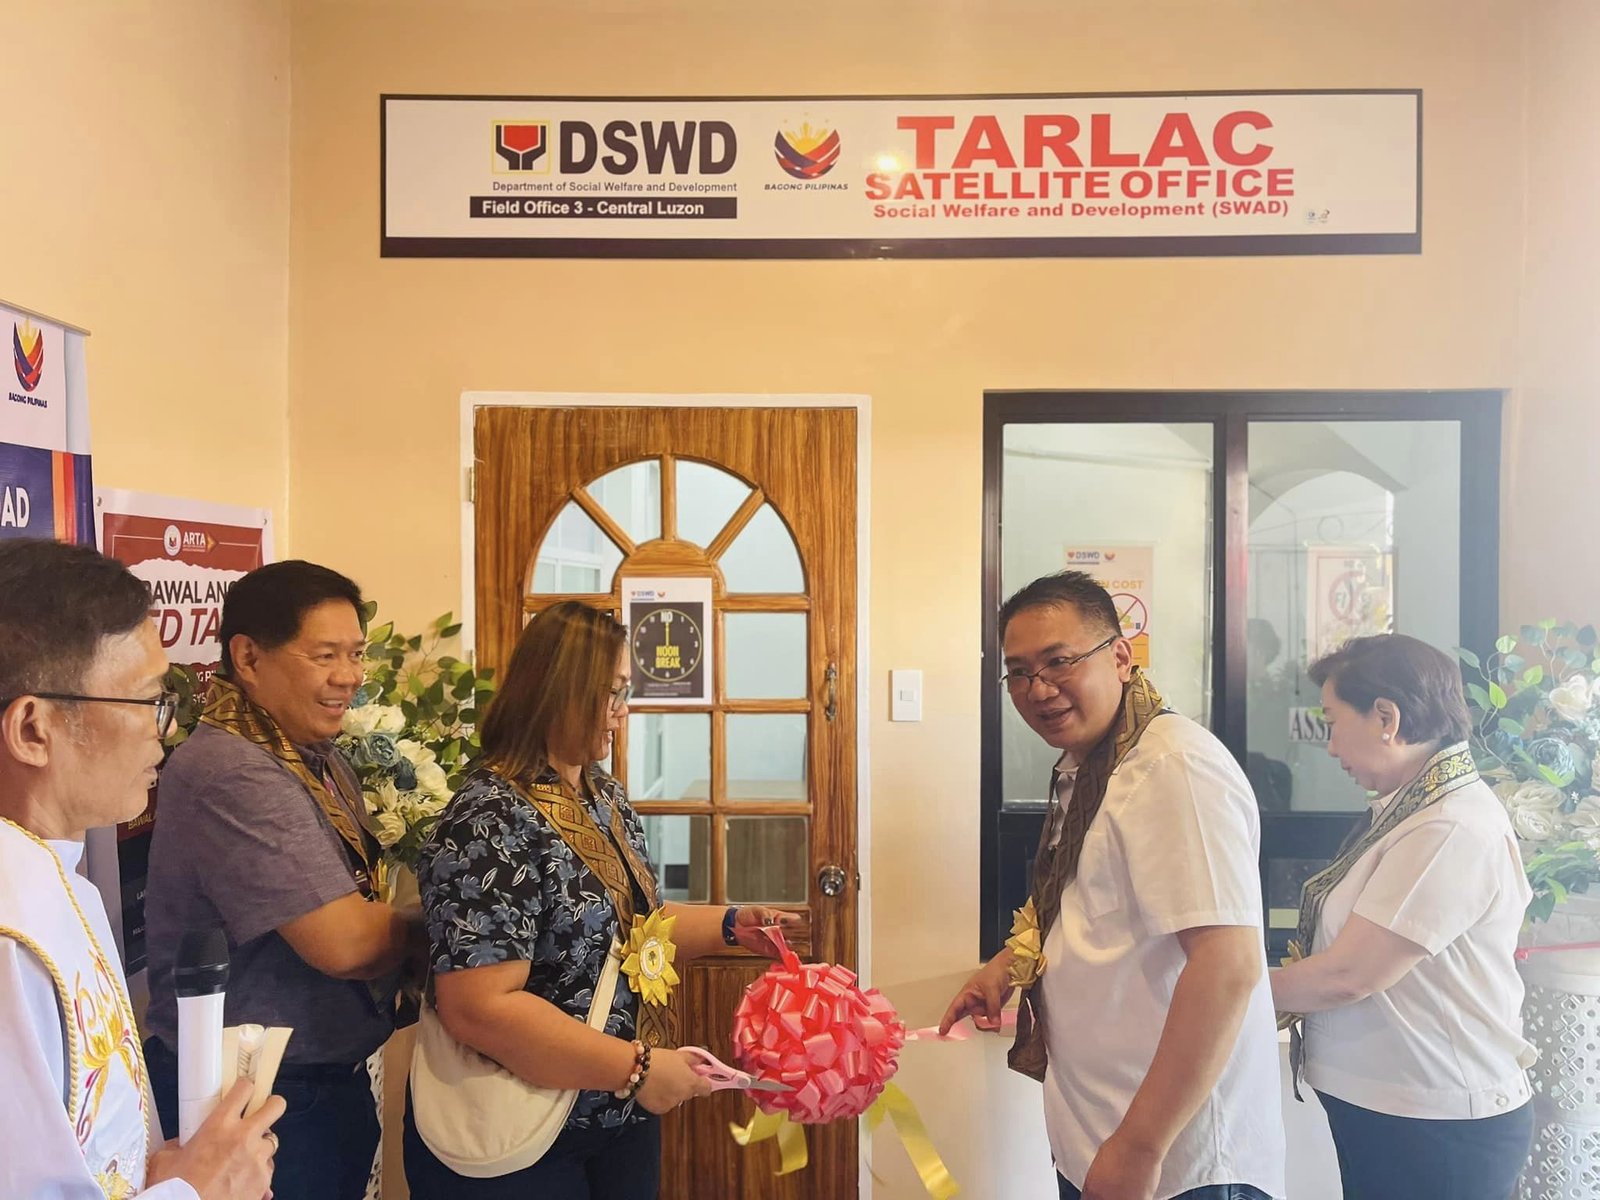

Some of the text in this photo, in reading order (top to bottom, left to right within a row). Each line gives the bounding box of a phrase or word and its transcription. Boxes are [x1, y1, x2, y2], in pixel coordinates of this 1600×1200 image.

[559, 119, 738, 175] DSWD
[896, 110, 1275, 169] TARLAC
[492, 181, 738, 194] Department of Social Welfare and Development
[764, 183, 849, 191] BAGONG PILIPINAS
[865, 168, 1295, 200] SATELLITE OFFICE
[482, 200, 520, 215] Field
[524, 200, 570, 215] Office
[574, 201, 583, 215] 3
[597, 201, 653, 215] Central
[657, 202, 705, 216] Luzon
[873, 200, 1289, 219] Social Welfare and Development (SWAD)
[183, 531, 206, 546] ARTA
[1112, 580, 1144, 589] COST
[190, 607, 221, 646] TA
